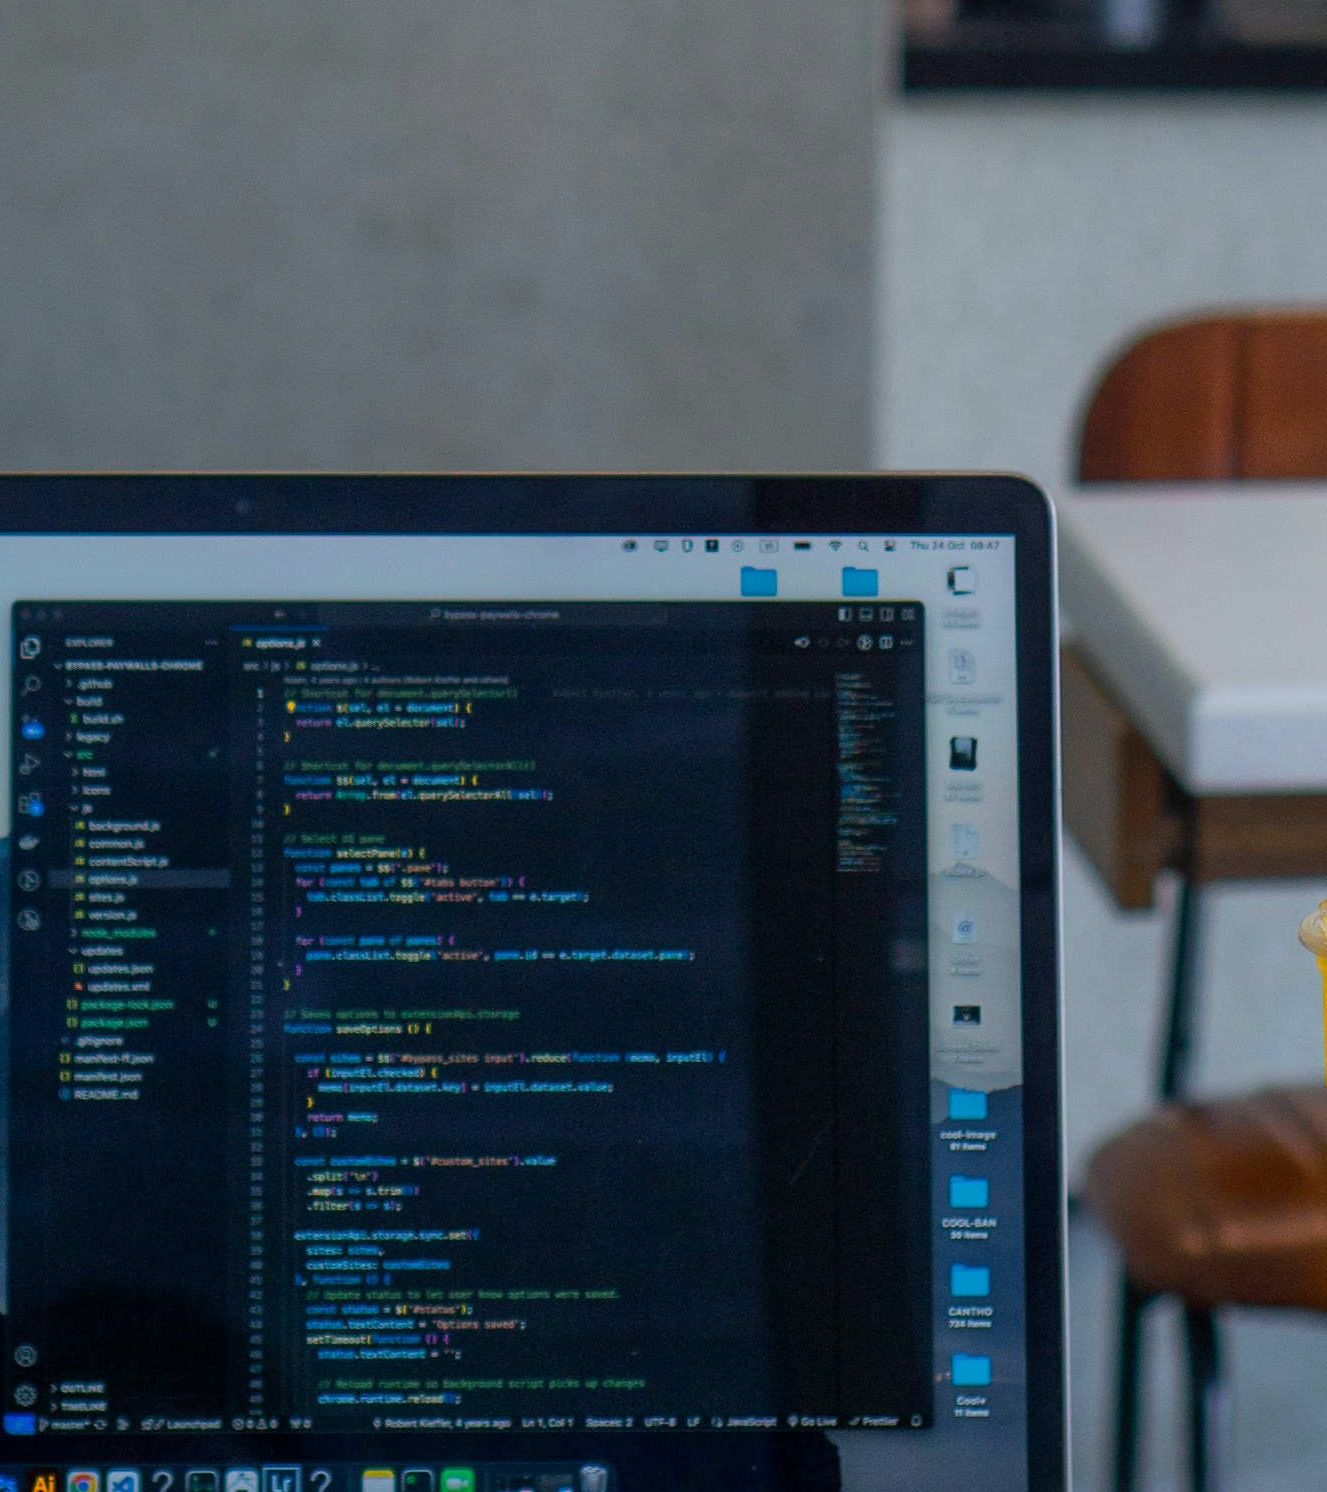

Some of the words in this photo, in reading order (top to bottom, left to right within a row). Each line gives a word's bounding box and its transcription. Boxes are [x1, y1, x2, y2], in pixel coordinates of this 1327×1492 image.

[911, 540, 930, 551] Thu
[946, 540, 965, 551] Oct
[65, 637, 114, 647] EXPLORER
[256, 638, 306, 649] options.js
[76, 696, 103, 707] build
[76, 731, 110, 744] legacy
[88, 820, 160, 833] background.js
[89, 839, 144, 850] common.js
[73, 1088, 139, 1100] README.md
[940, 1130, 996, 1140] cool-image
[942, 1217, 997, 1227] COOL-BAN
[948, 1306, 993, 1316] CANTHO
[966, 1319, 991, 1327] items
[60, 1382, 105, 1393] OUTLINE
[61, 1400, 107, 1411] TIMELINE
[963, 1408, 989, 1417] items
[167, 1418, 222, 1430] Launchpad
[384, 1418, 419, 1428] Robert
[463, 1418, 491, 1429] years
[491, 1418, 511, 1429] ago
[727, 1416, 777, 1427] JavaScript
[271, 1473, 291, 1492] Lr
